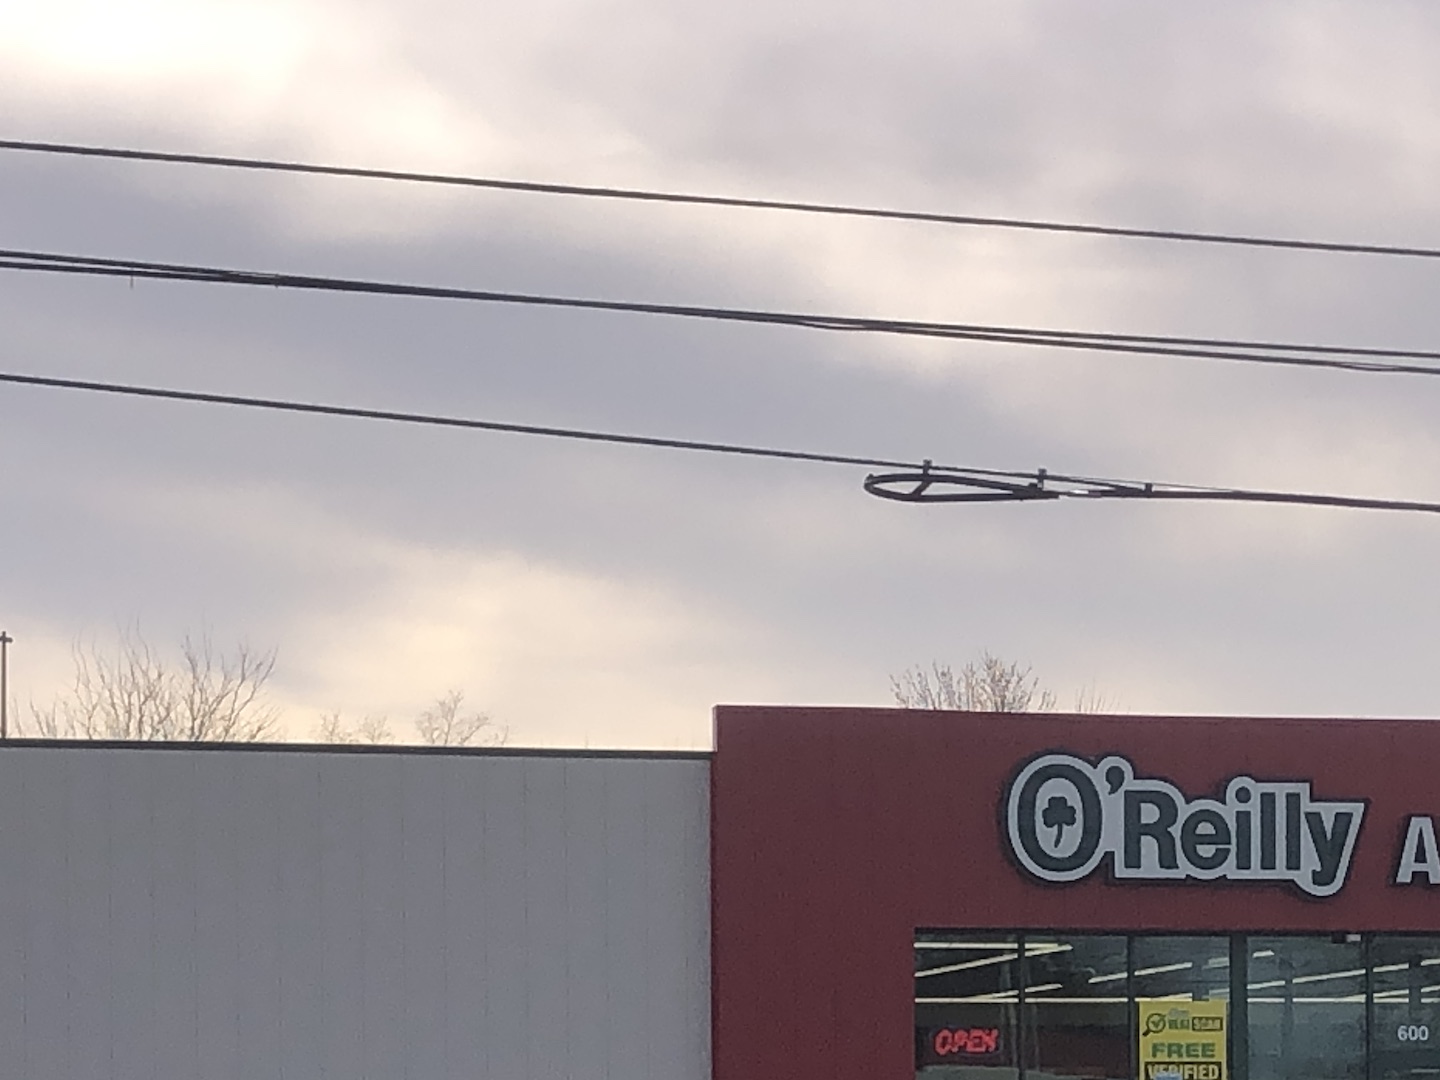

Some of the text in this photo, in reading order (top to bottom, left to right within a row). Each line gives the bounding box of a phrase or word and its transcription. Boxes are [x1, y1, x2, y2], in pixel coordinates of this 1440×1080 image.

[1012, 760, 1361, 891] O'Reilly
[935, 1028, 999, 1056] OPEN
[1397, 1025, 1429, 1041] 600
[1151, 1042, 1217, 1059] FREE
